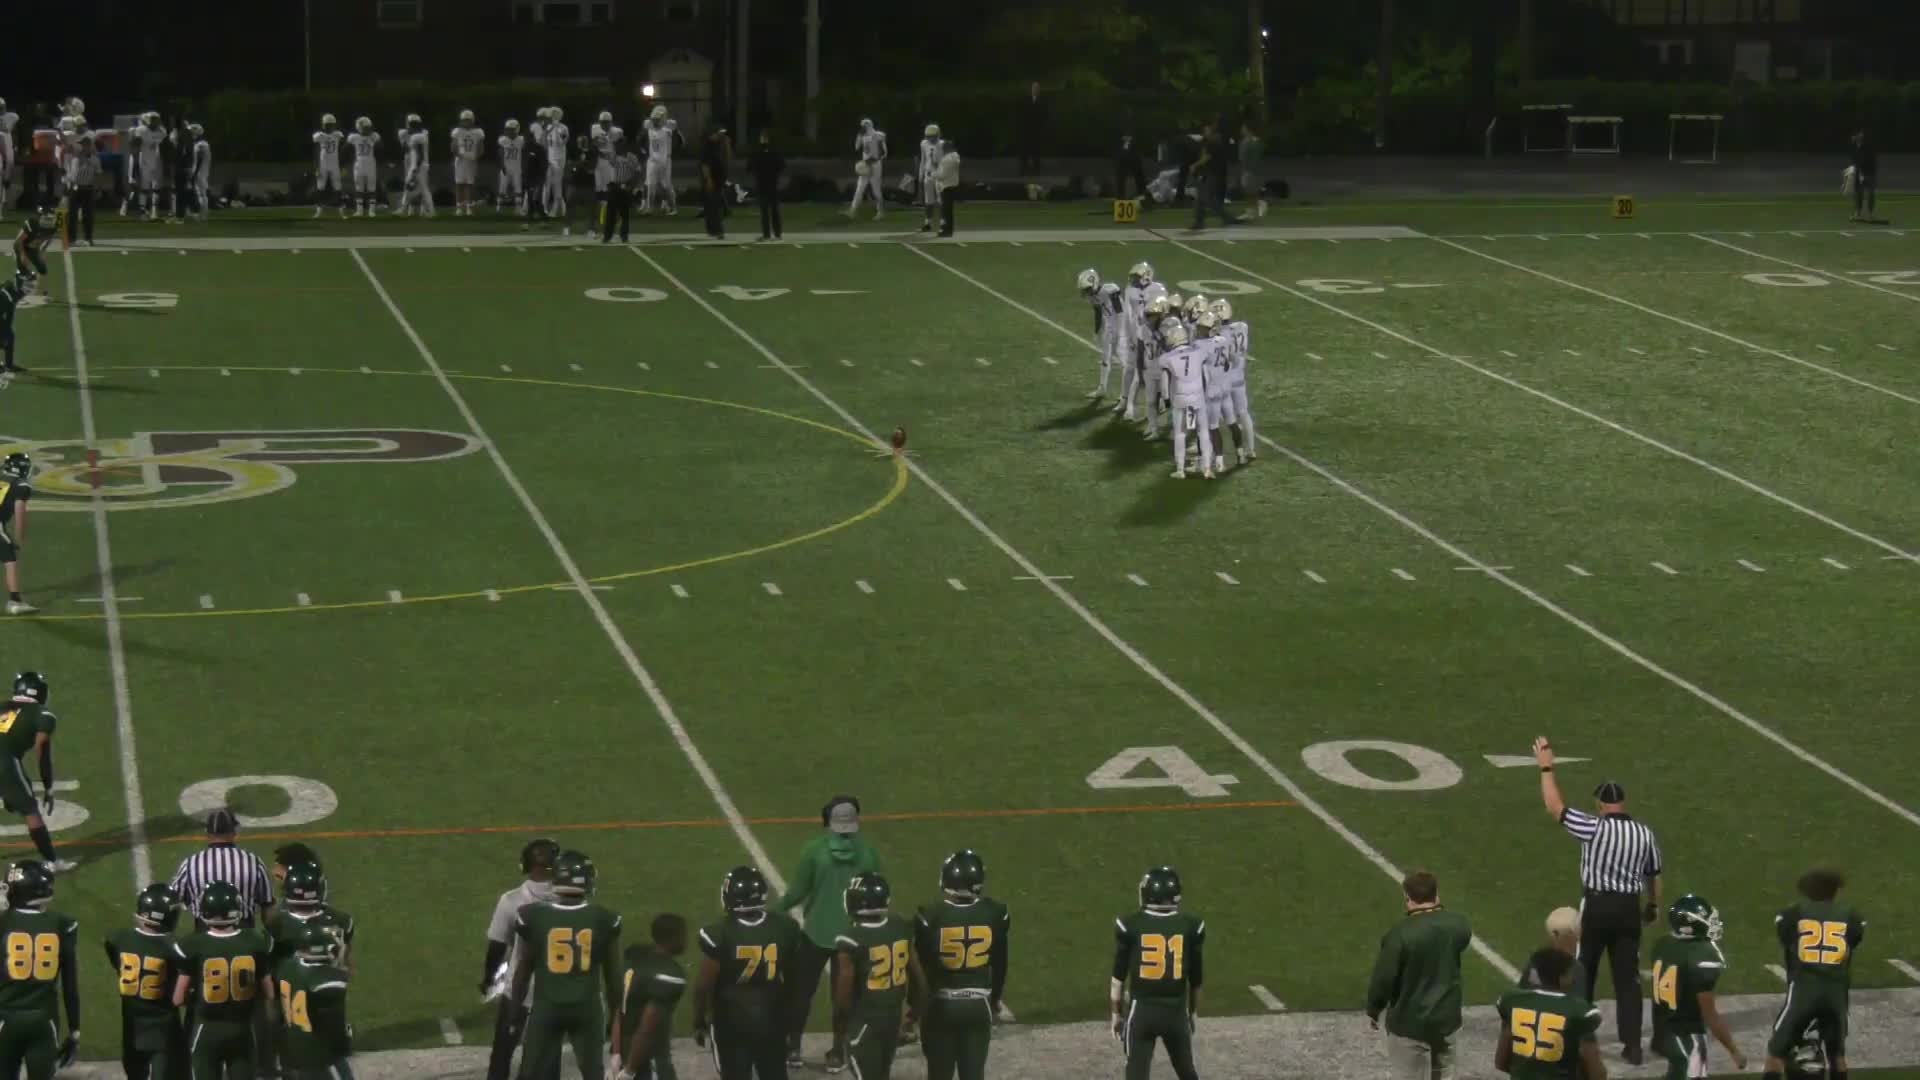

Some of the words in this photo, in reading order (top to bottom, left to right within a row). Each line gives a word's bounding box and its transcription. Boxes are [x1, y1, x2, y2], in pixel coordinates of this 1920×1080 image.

[1118, 202, 1134, 218] 30
[1180, 355, 1190, 376] 7
[7, 931, 60, 981] 88
[546, 927, 593, 974] 61
[735, 943, 778, 984] 71
[867, 939, 909, 990] 28
[940, 925, 993, 970] 52
[1139, 933, 1184, 979] 31
[1797, 919, 1848, 966] 25
[119, 952, 166, 1000] 82
[203, 954, 257, 1004] 80
[1652, 959, 1677, 1010] 14
[1510, 1007, 1567, 1063] 55
